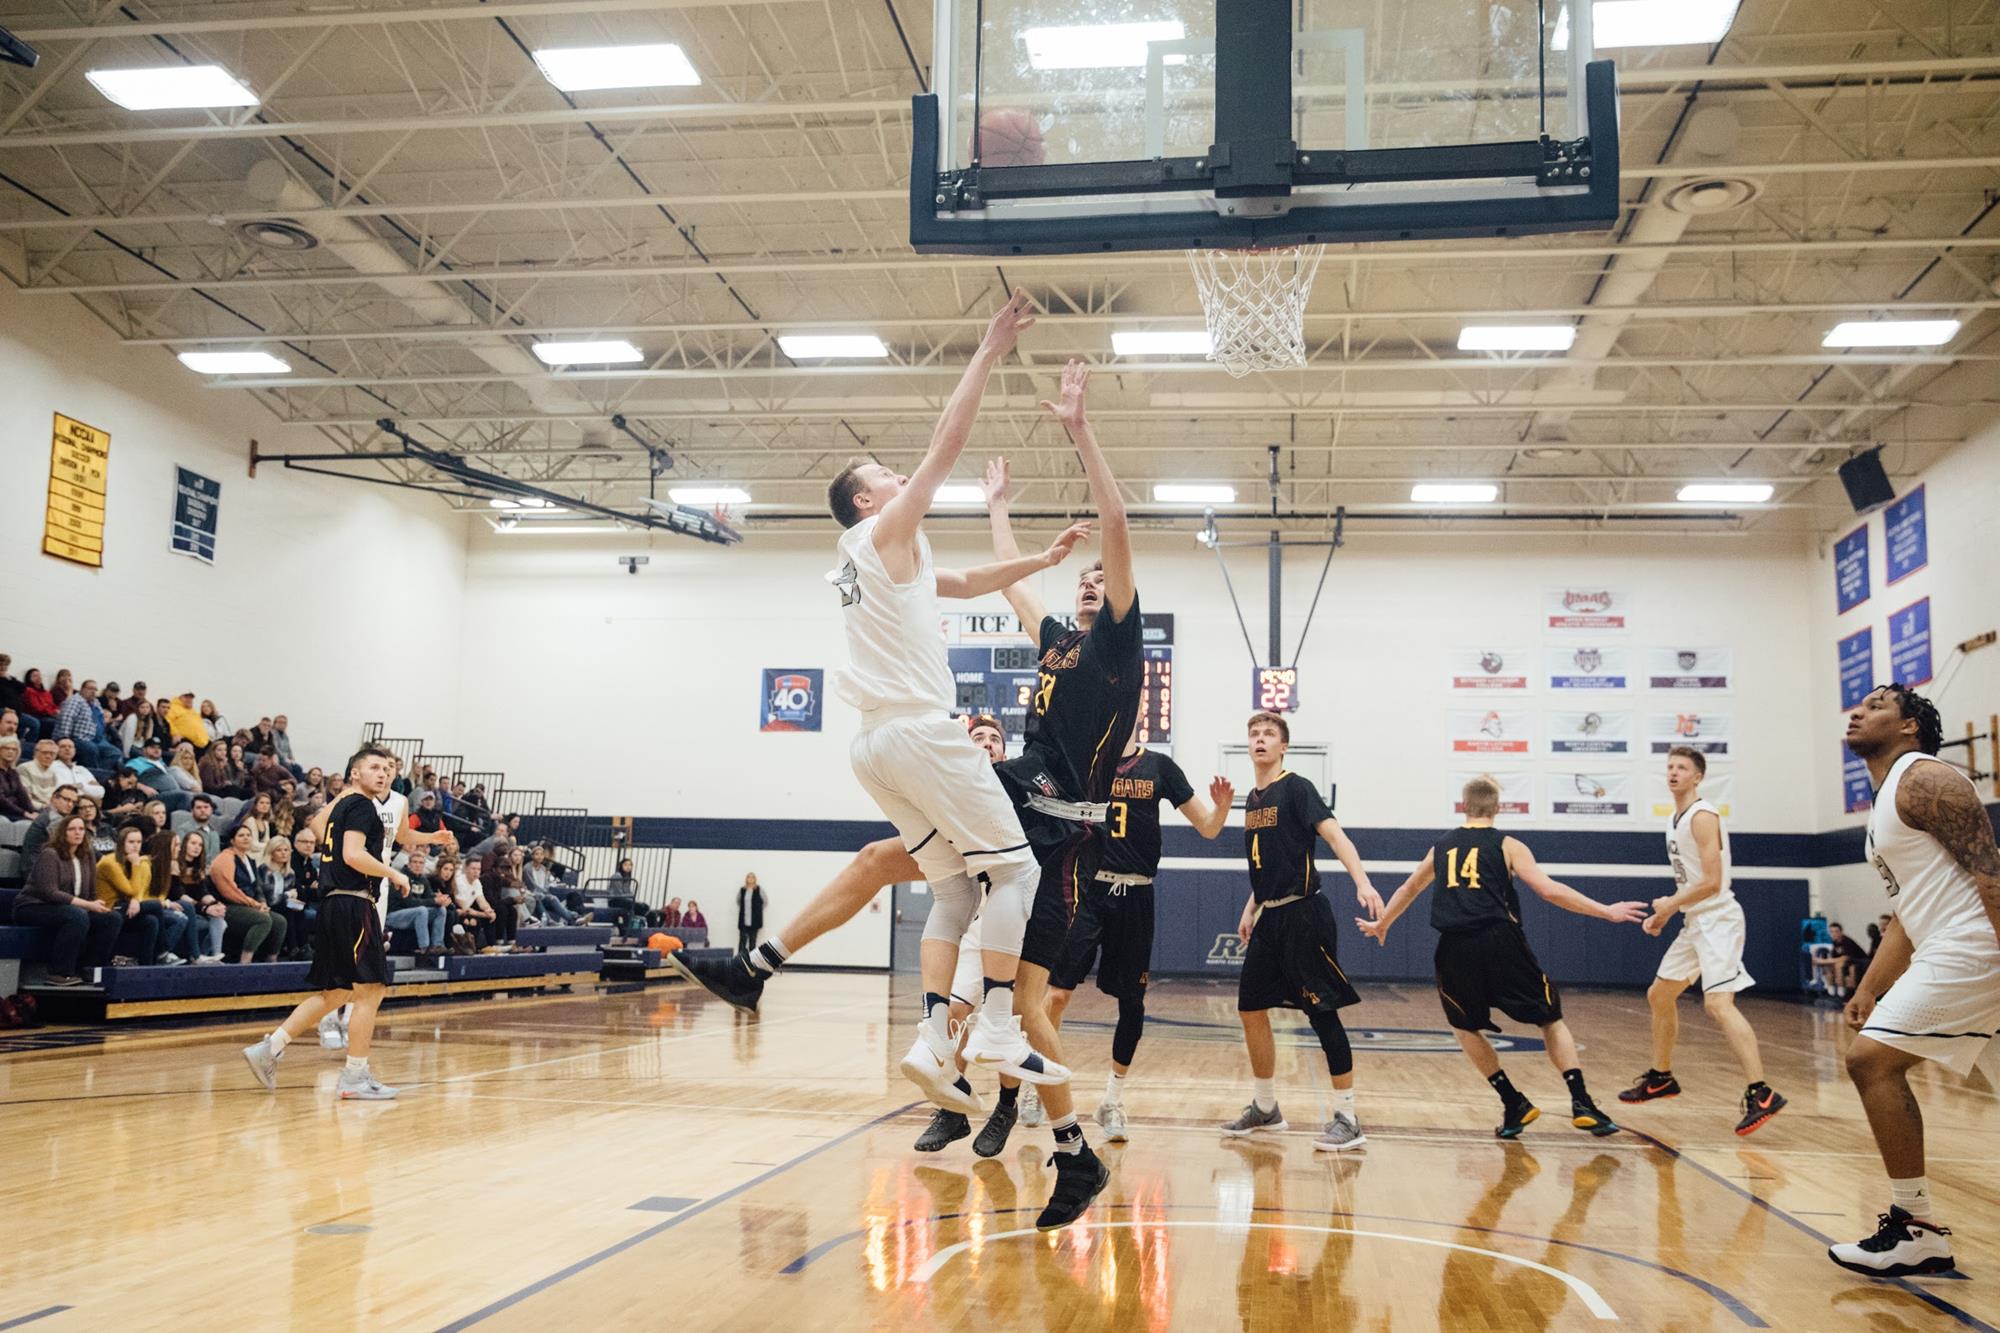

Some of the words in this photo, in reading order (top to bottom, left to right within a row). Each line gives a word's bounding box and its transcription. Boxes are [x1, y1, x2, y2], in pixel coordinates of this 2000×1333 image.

[966, 616, 1009, 633] TCF
[956, 672, 984, 684] HOME
[774, 688, 808, 710] 40
[1018, 686, 1031, 705] 2
[1161, 688, 1170, 702] 0
[1261, 684, 1289, 708] 22
[1139, 729, 1149, 743] 0
[1111, 778, 1154, 799] GARS
[379, 812, 394, 824] CU
[1111, 802, 1127, 837] 3
[1245, 806, 1278, 832] UGARS
[1446, 847, 1481, 889] 14
